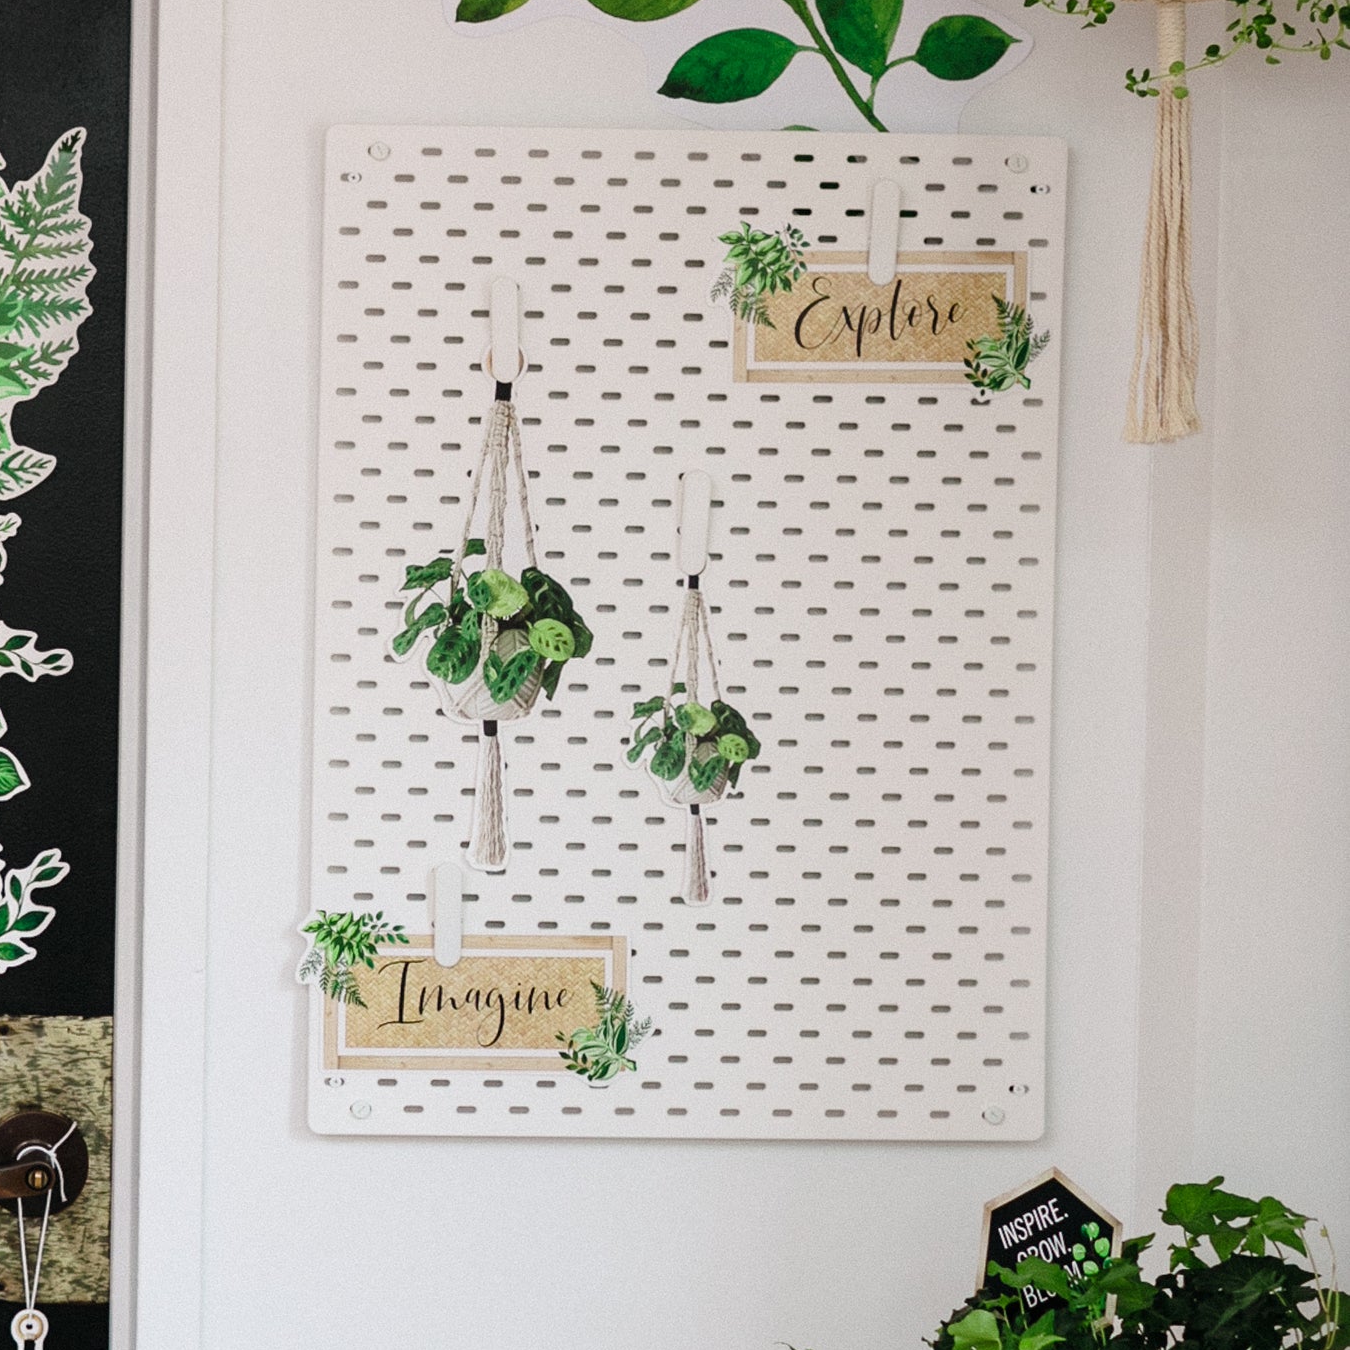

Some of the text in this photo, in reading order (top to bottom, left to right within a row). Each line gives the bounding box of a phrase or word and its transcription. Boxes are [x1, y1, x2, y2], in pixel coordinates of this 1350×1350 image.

[794, 276, 970, 357] Explore
[376, 958, 574, 1048] Imagine
[997, 1198, 1069, 1250] INSPIRE.
